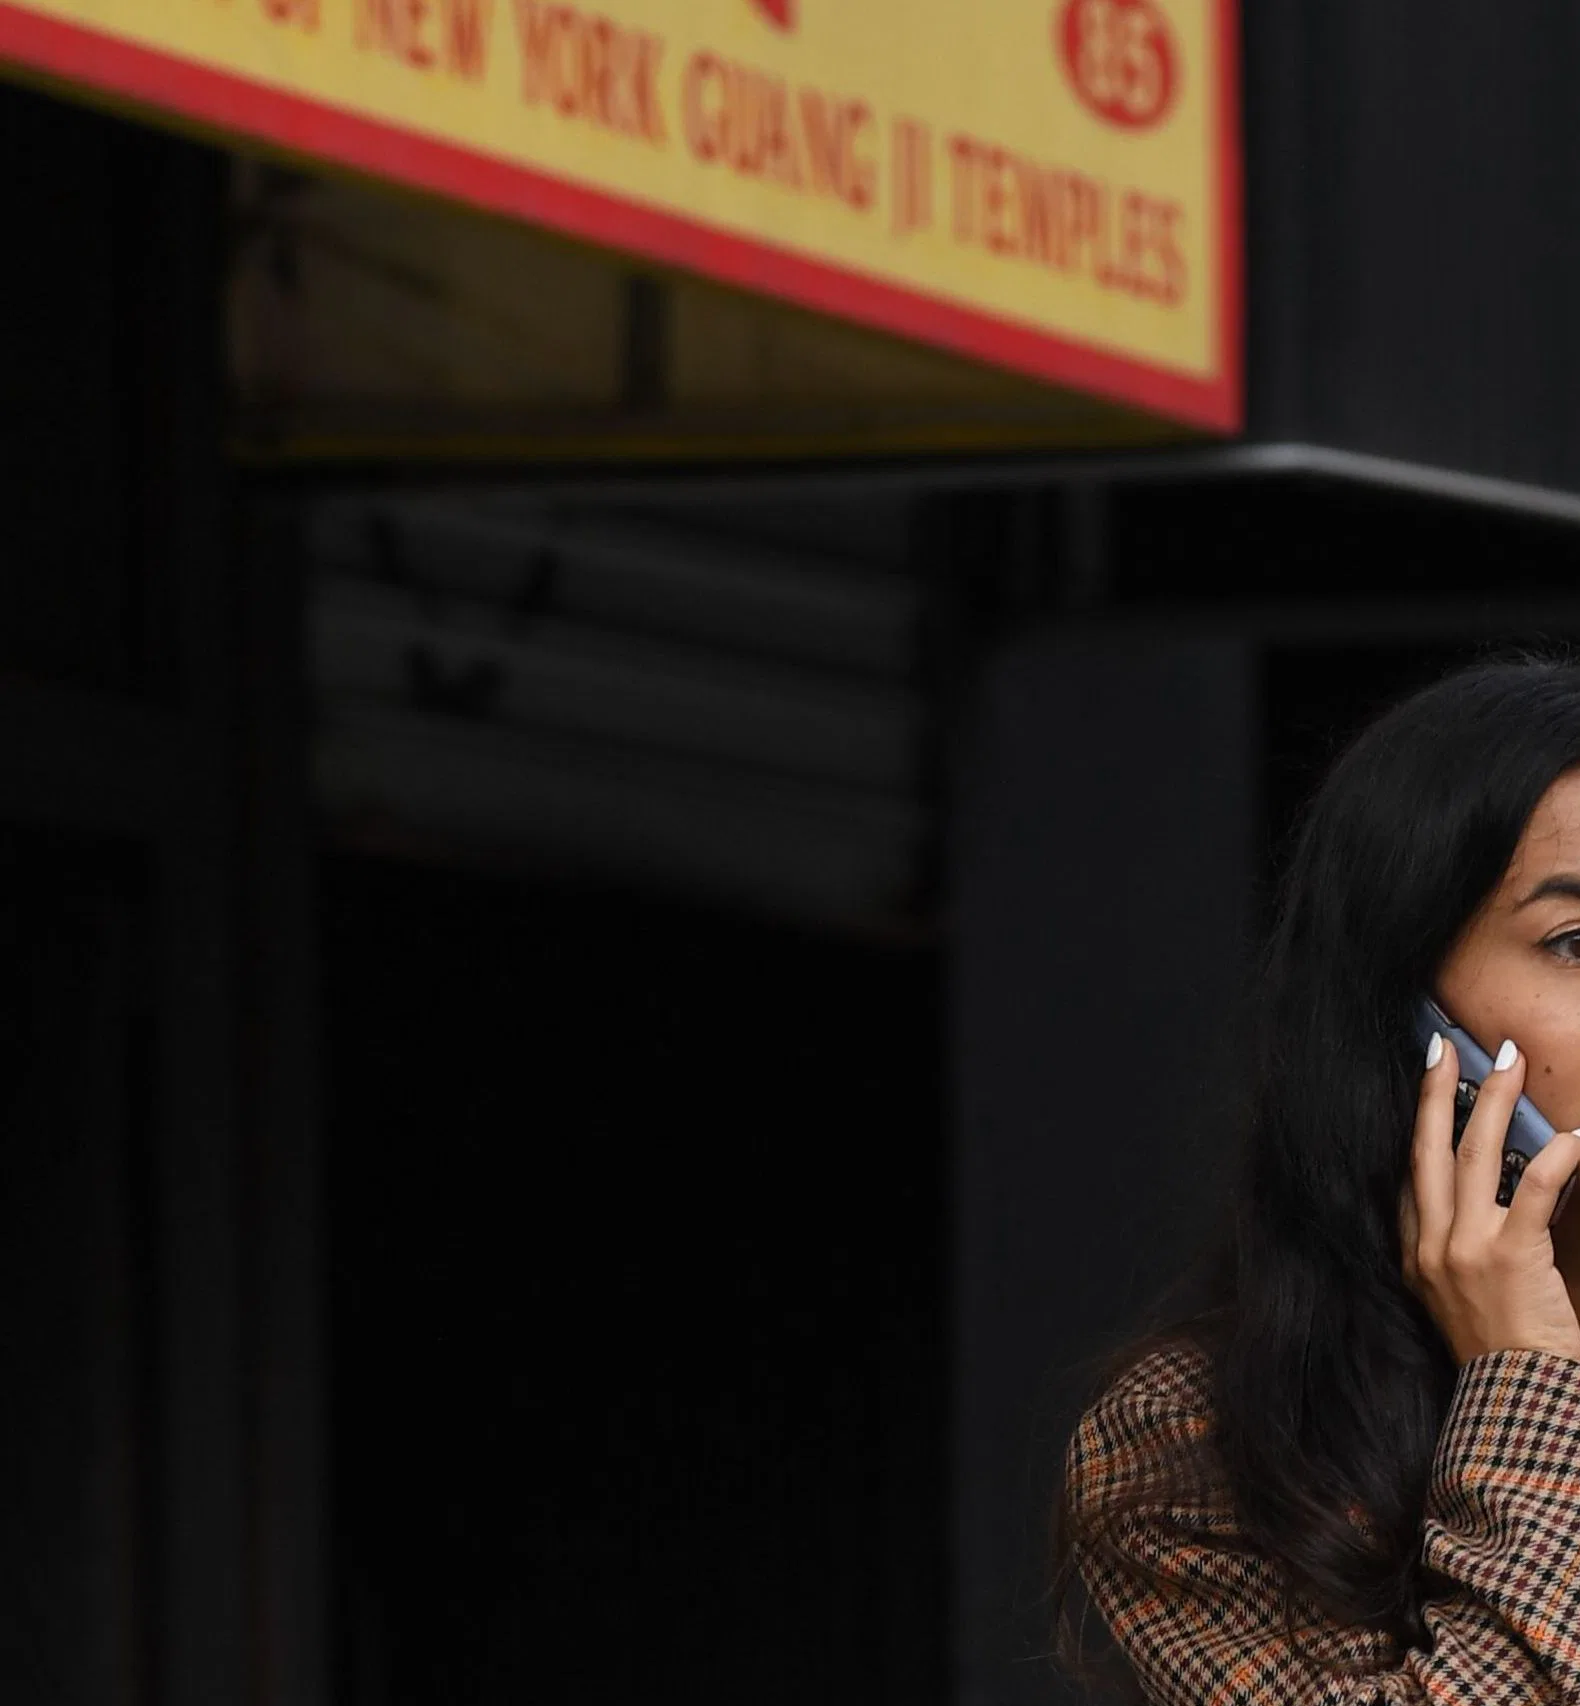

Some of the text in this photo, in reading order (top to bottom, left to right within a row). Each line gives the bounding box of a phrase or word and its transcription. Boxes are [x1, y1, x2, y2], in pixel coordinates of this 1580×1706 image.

[516, 0, 668, 148] YORK
[681, 48, 874, 214] GUANG
[946, 133, 1188, 309] TEMPLES
